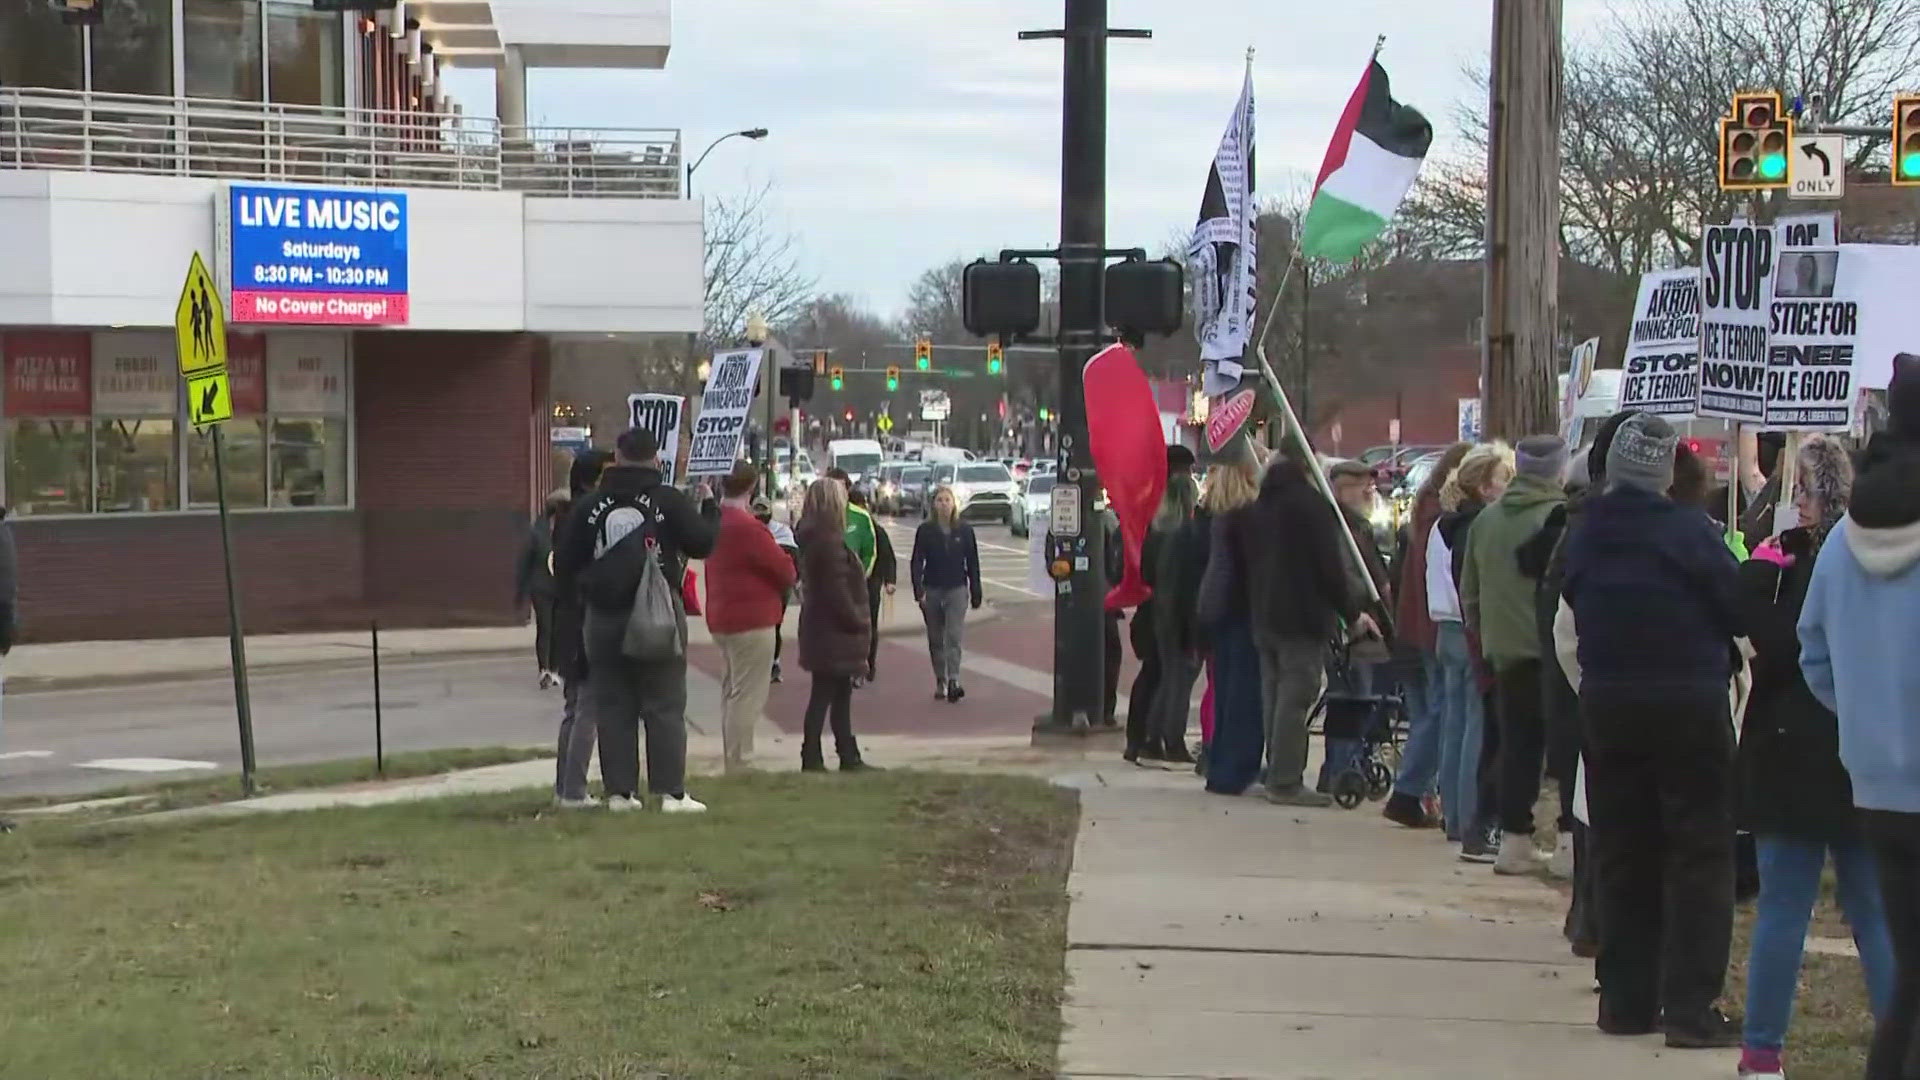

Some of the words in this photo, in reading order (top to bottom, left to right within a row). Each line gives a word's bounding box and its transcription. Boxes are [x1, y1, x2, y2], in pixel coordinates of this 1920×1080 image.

[1796, 180, 1835, 193] ONLY
[240, 195, 300, 228] LIVE
[307, 198, 400, 231] MUSIC
[283, 240, 361, 264] Saturdays
[255, 264, 287, 283] 8:30
[290, 265, 313, 284] PM
[327, 266, 364, 285] 10:30
[366, 267, 389, 286] PM
[1705, 226, 1772, 311] STOP
[256, 296, 277, 314] No
[280, 298, 325, 315] Cover
[327, 298, 387, 320] Charge!
[1647, 286, 1700, 318] AKRON
[1633, 317, 1700, 342] MINNEAPOLI
[1770, 302, 1817, 336] STICE
[1819, 301, 1857, 336] FOR
[1704, 322, 1720, 359] ICE
[1721, 324, 1767, 364] TERROR
[1769, 344, 1854, 367] ENEE
[713, 360, 751, 390] AKRON
[1627, 353, 1698, 374] STOP
[1702, 362, 1765, 393] NOW!
[1623, 376, 1647, 402] ICE
[1648, 373, 1697, 400] TERROR
[1767, 371, 1798, 401] OLE
[1800, 371, 1851, 401] GOOD
[633, 399, 678, 451] STOP
[697, 416, 743, 434] STOP
